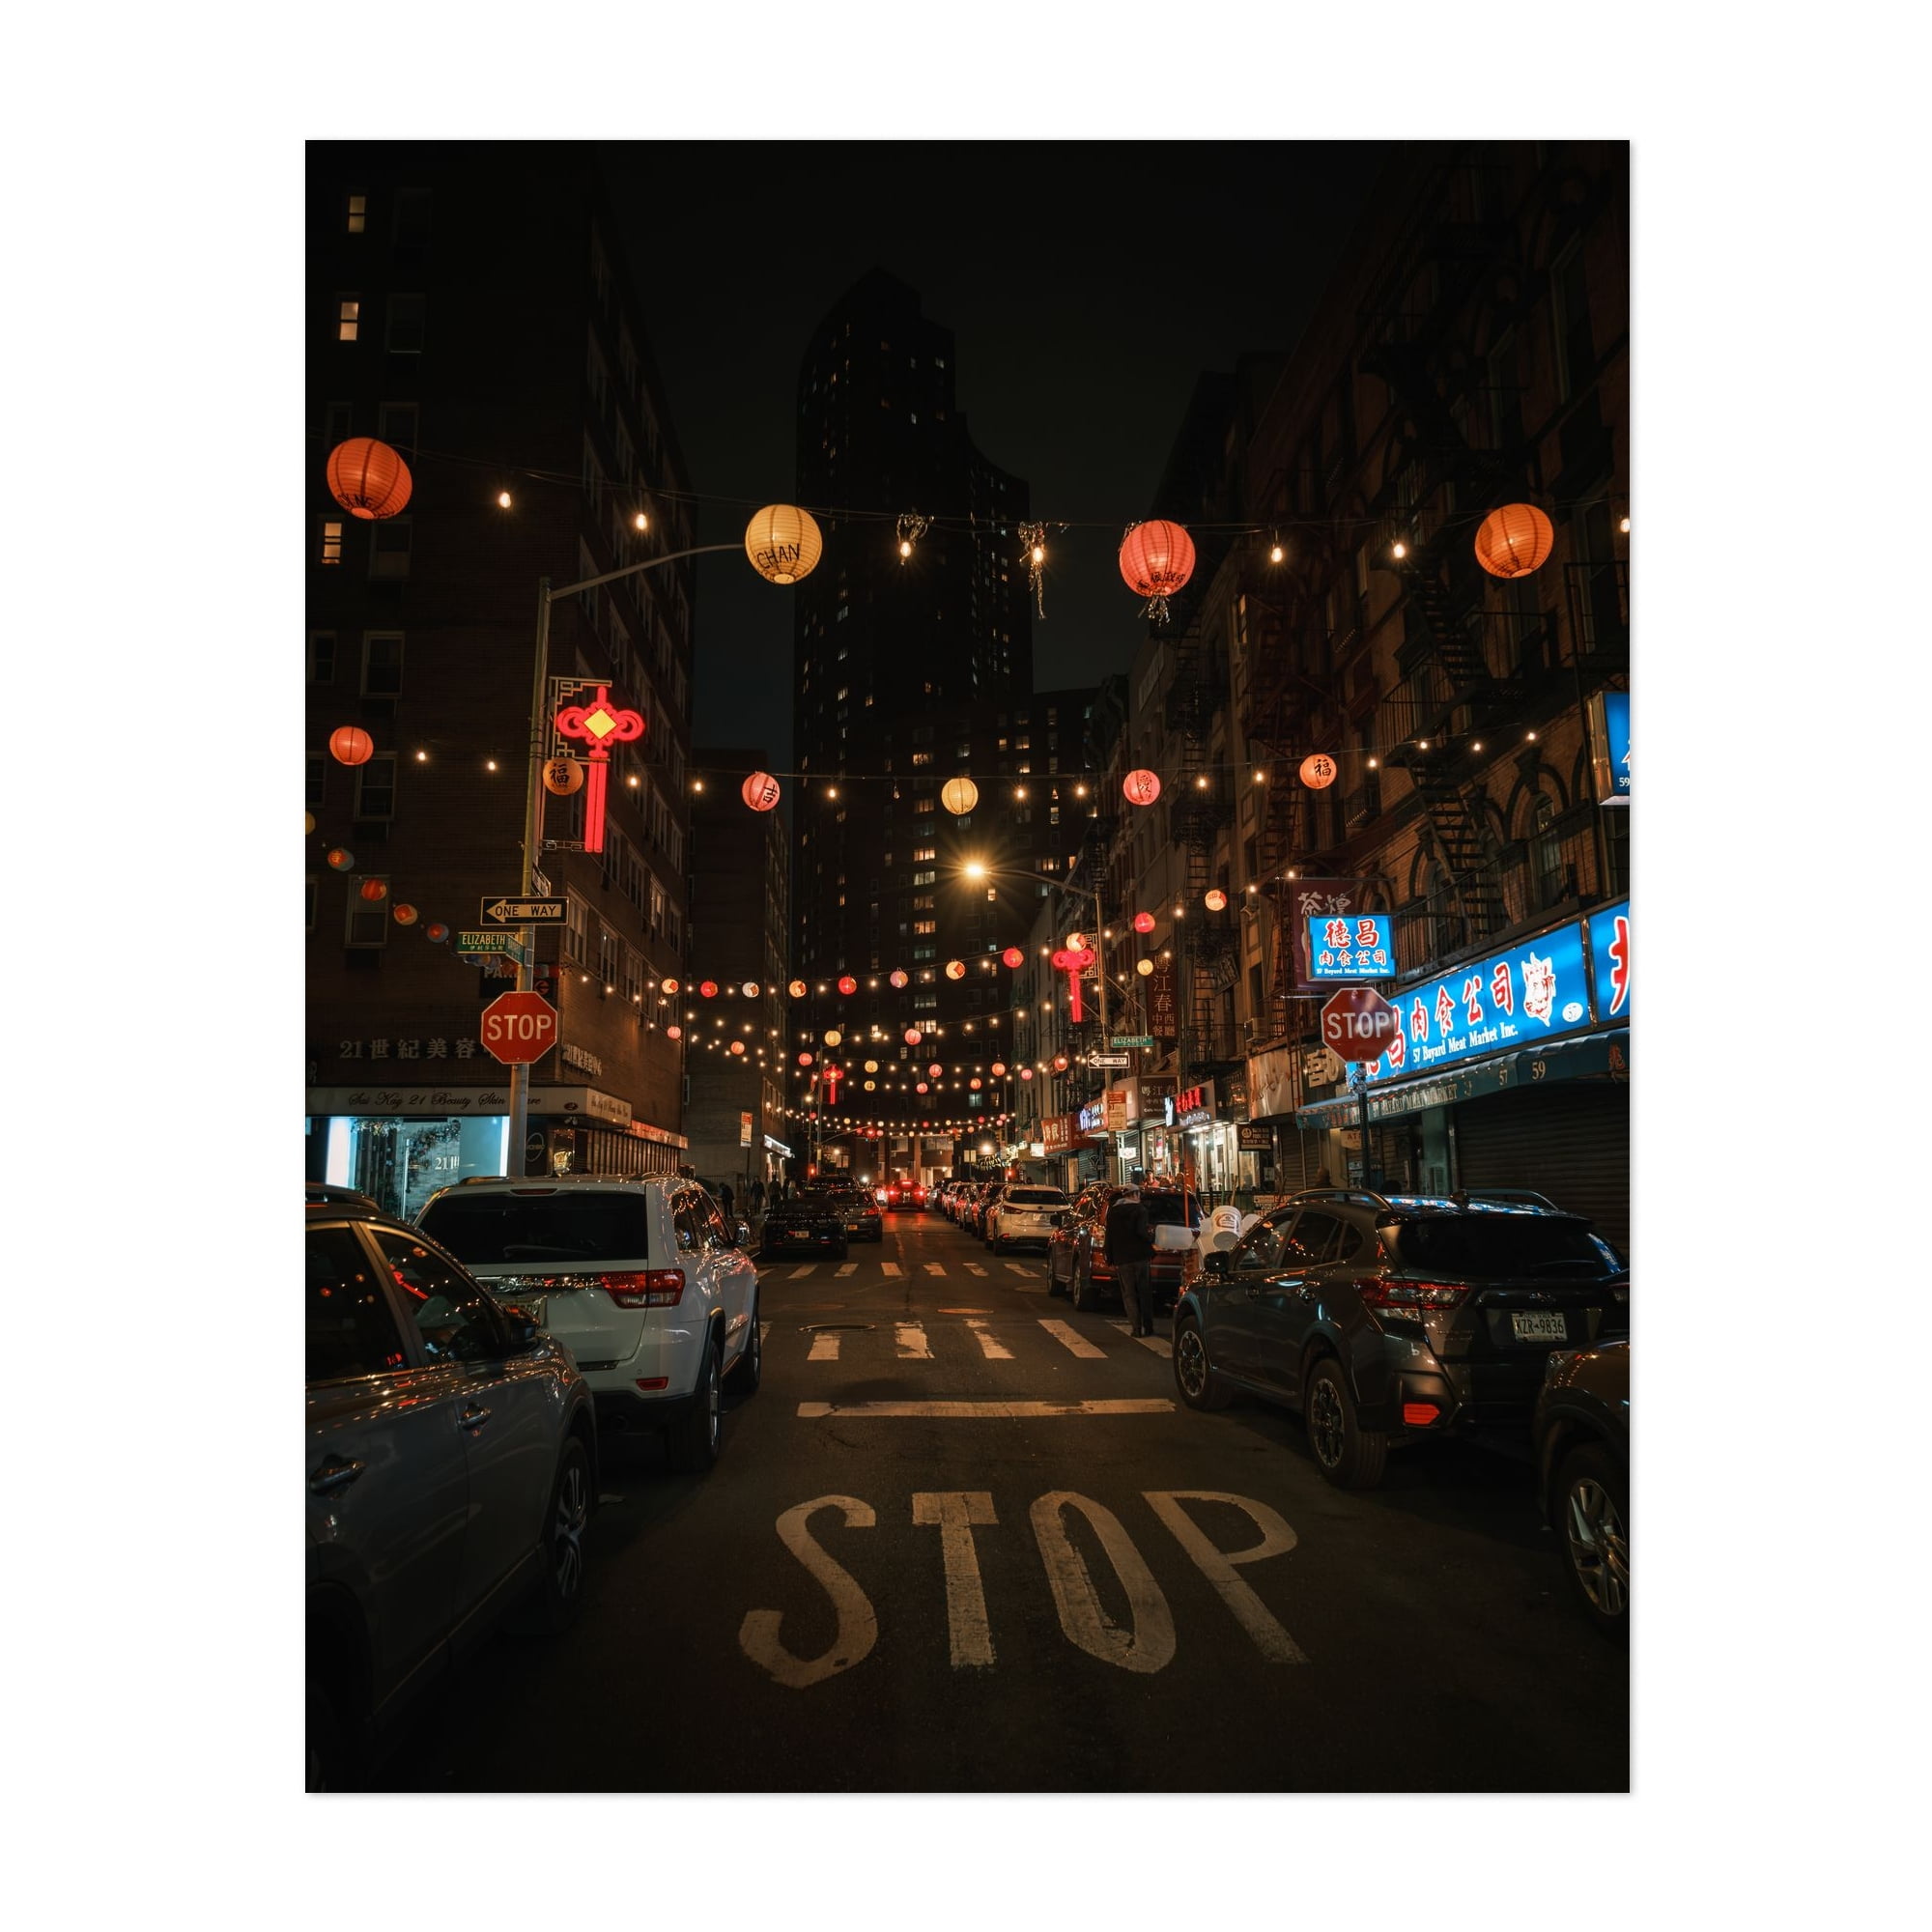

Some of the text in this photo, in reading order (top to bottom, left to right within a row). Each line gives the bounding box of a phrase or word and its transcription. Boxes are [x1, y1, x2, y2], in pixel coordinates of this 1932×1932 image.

[755, 544, 801, 571] CHAN
[549, 763, 570, 788] 福
[1315, 758, 1331, 778] 福
[495, 905, 556, 917] ONE WAY
[462, 934, 506, 946] ELIZABETH
[1322, 918, 1379, 949] 德昌
[1318, 950, 1387, 967] 肉食公司
[486, 1013, 552, 1041] STOP
[1327, 1011, 1390, 1039] STOP
[1412, 1021, 1519, 1064] 57 Bayard Meat Market Inc.
[1499, 1068, 1508, 1087] 57
[1531, 1060, 1546, 1081] 59
[409, 1094, 427, 1105] 21
[431, 1092, 471, 1110] Beauty
[738, 1490, 1309, 1690] STOP
